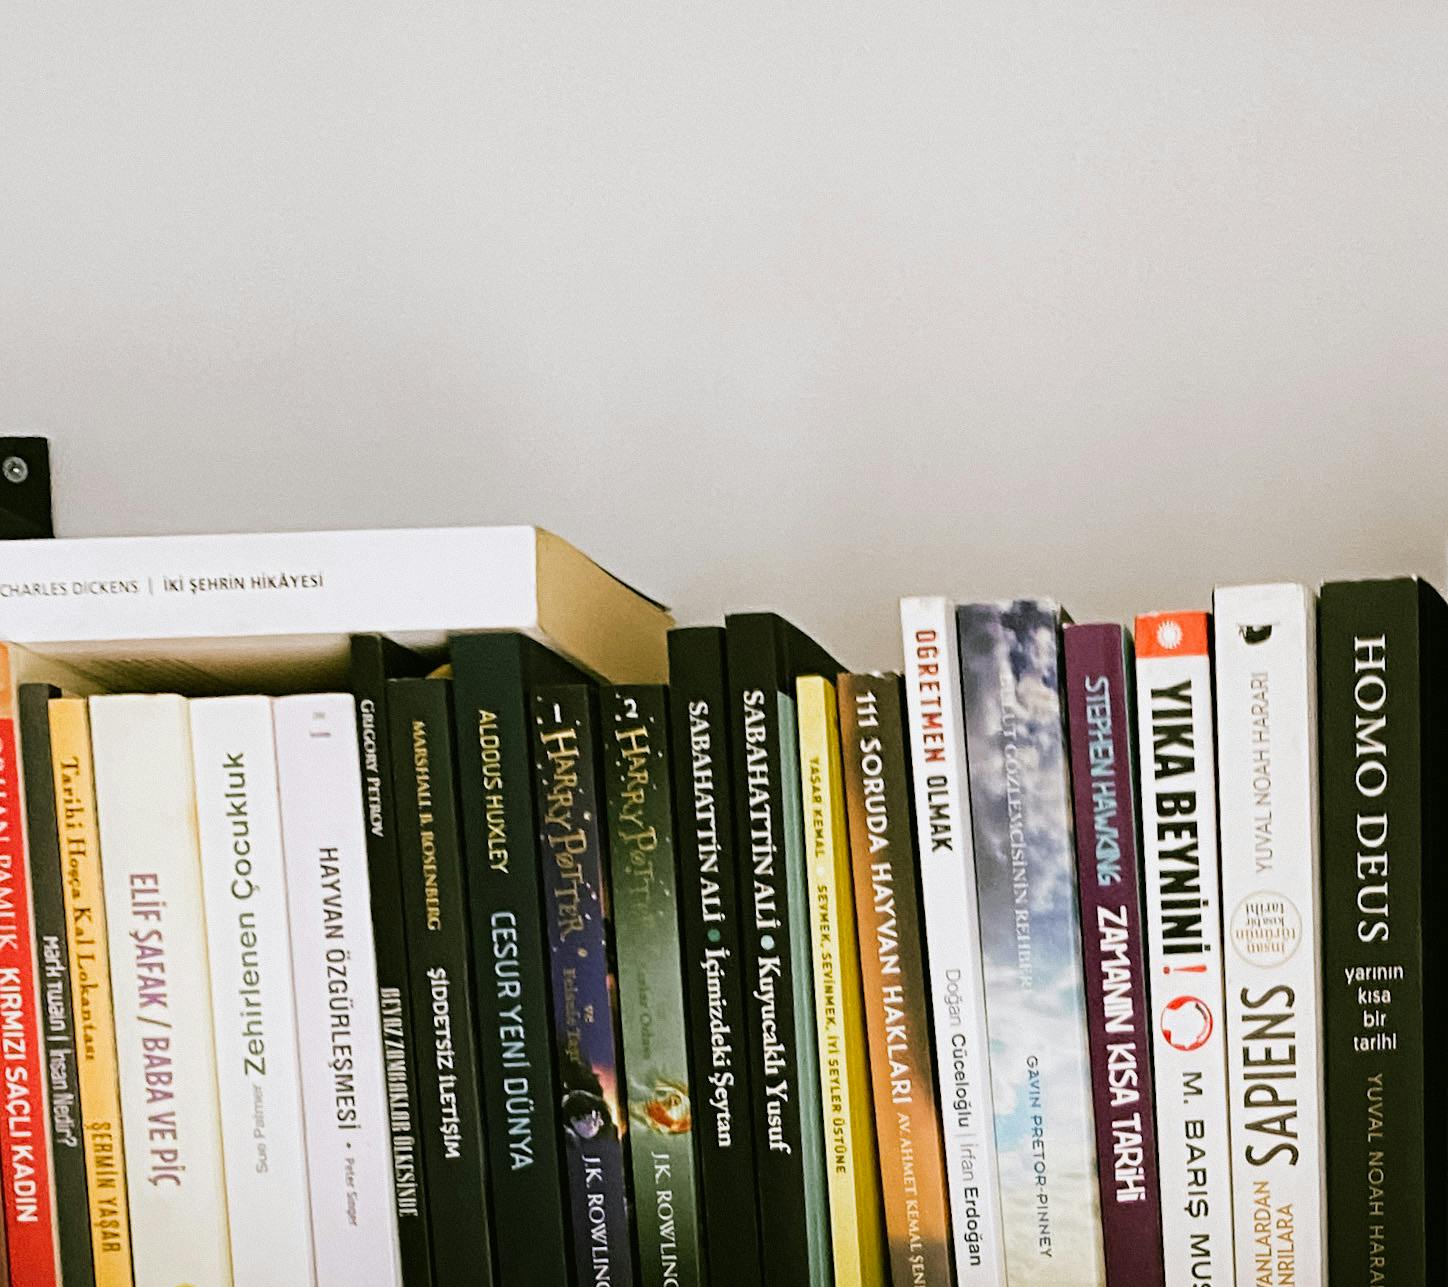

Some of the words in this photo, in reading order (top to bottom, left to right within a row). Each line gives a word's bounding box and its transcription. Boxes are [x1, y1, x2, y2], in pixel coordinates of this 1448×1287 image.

[73, 579, 139, 594] DICKENS
[163, 575, 184, 592] İKİ
[189, 575, 244, 593] ŞEHRİN
[251, 571, 324, 589] HİKÂYESİ
[855, 690, 879, 727] 111
[1252, 671, 1269, 748] HARARI
[1354, 635, 1387, 798] HOMO
[478, 709, 502, 789] ALDOUS
[688, 701, 721, 873] SABAHATTİN
[743, 689, 777, 876] SABAHATTİN
[1253, 752, 1272, 807] NOAH
[223, 751, 261, 899] Çocukluk
[485, 795, 508, 873] HUXLEY
[861, 738, 889, 853] SORUDA
[1256, 813, 1272, 873] YUVAL
[1356, 813, 1389, 943] DEUS
[130, 872, 167, 922] ELİF
[319, 847, 344, 939] HAYVAN
[701, 879, 724, 921] ALİ
[755, 886, 781, 929] ALİ
[870, 862, 903, 981] HAYVAN
[130, 927, 171, 1014] ŞAFAK
[238, 912, 266, 1076] Zehirlenen
[490, 912, 522, 998] CESUR
[1096, 905, 1135, 1032] ZAMANIN
[1, 967, 26, 1062] KIRMIZI
[325, 945, 361, 1131] ÖZGÜRLEŞMESİ
[498, 1005, 531, 1069] YENİ
[701, 946, 731, 1067] İçimizdeki
[754, 956, 786, 1074] Kuyucaklı
[882, 987, 914, 1105] HAKLARI
[5, 1065, 32, 1137] SAÇLI
[142, 1036, 173, 1102] BABA
[1026, 1055, 1043, 1108] GAVIN
[1107, 1042, 1138, 1106] KISA
[1182, 1072, 1202, 1104] M.
[1240, 985, 1298, 1167] SAPIENS
[1367, 1073, 1384, 1142] YUVAL
[148, 1109, 176, 1141] VE
[503, 1077, 533, 1171] DÜNYA
[708, 1072, 735, 1148] Şeytan
[766, 1082, 791, 1154] Yusuf
[10, 1145, 38, 1223] KADIN
[148, 1151, 186, 1186] PİÇ
[651, 1152, 671, 1186] J.K.
[1031, 1116, 1052, 1258] PRETOR-PINNEY
[1111, 1113, 1147, 1202] TARİHİ
[1184, 1120, 1208, 1218] BARIŞ
[1368, 1152, 1384, 1215] NOAH
